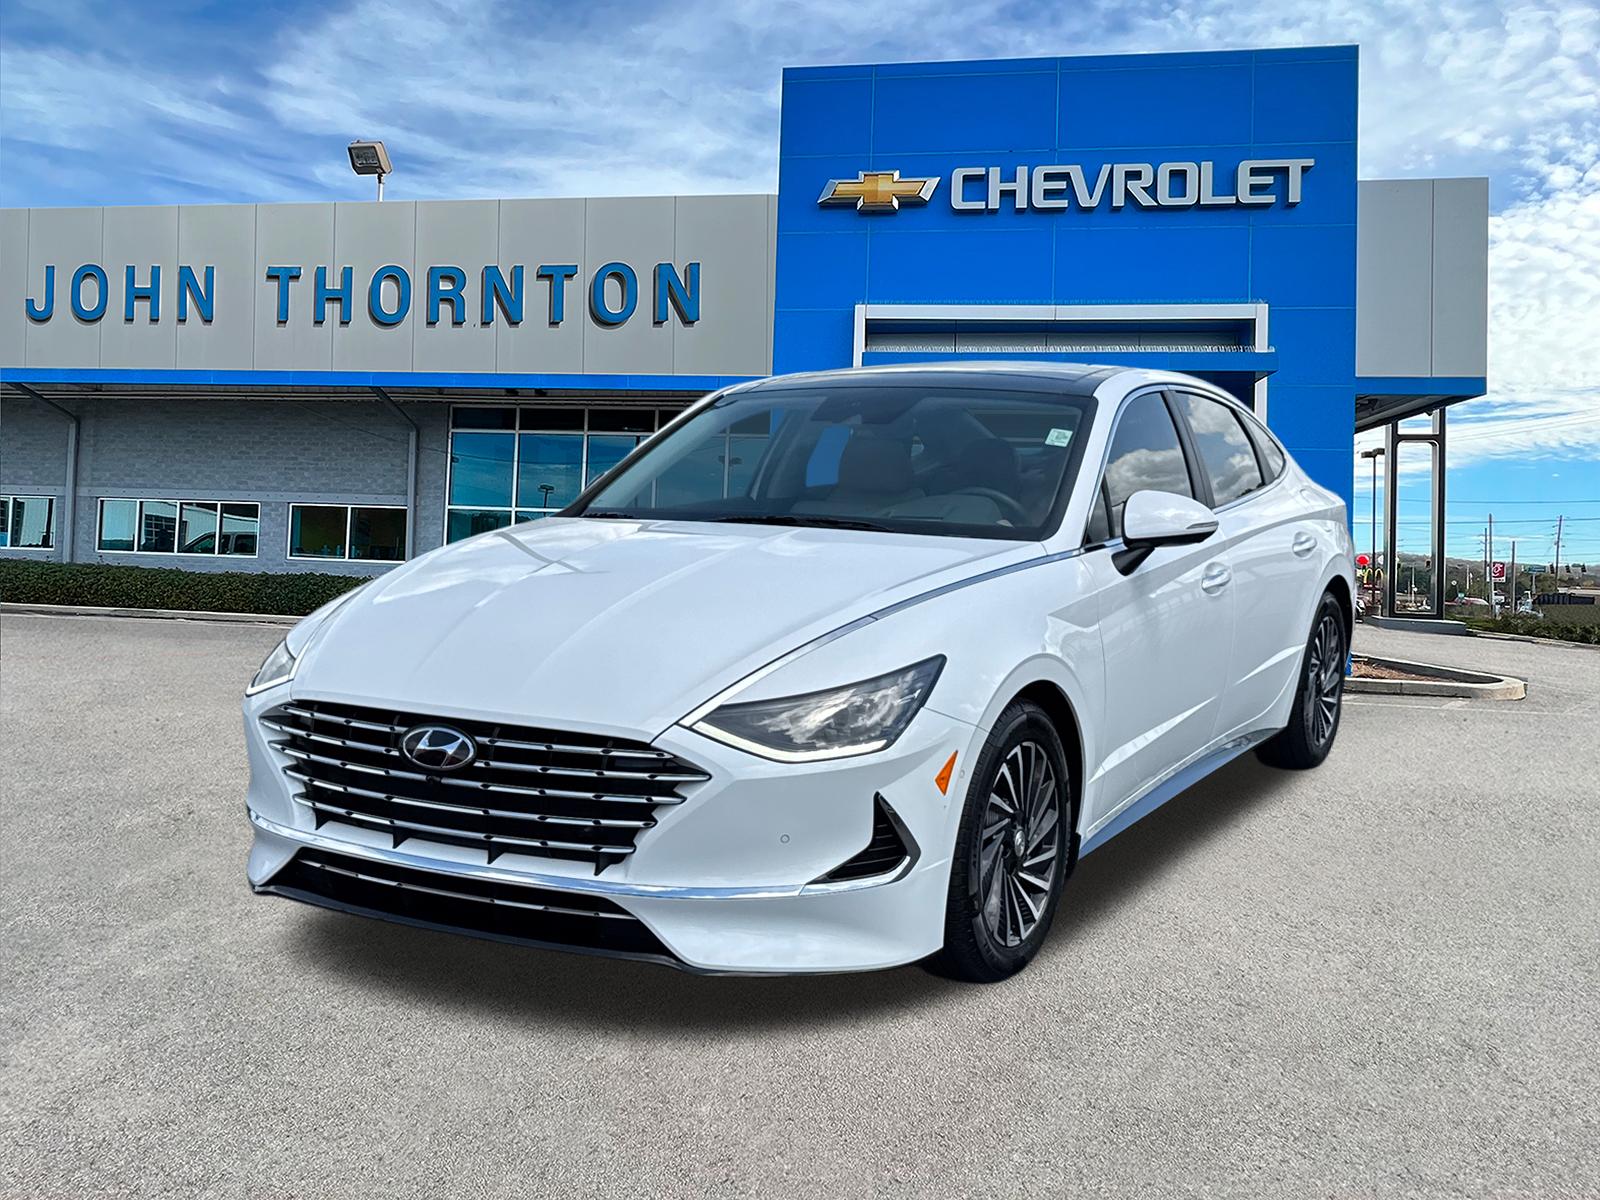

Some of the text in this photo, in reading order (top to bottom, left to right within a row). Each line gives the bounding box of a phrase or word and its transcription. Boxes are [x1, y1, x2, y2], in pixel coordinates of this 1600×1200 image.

[951, 158, 1315, 211] CHEVROLET
[25, 262, 701, 326] JOHN THORNTON
